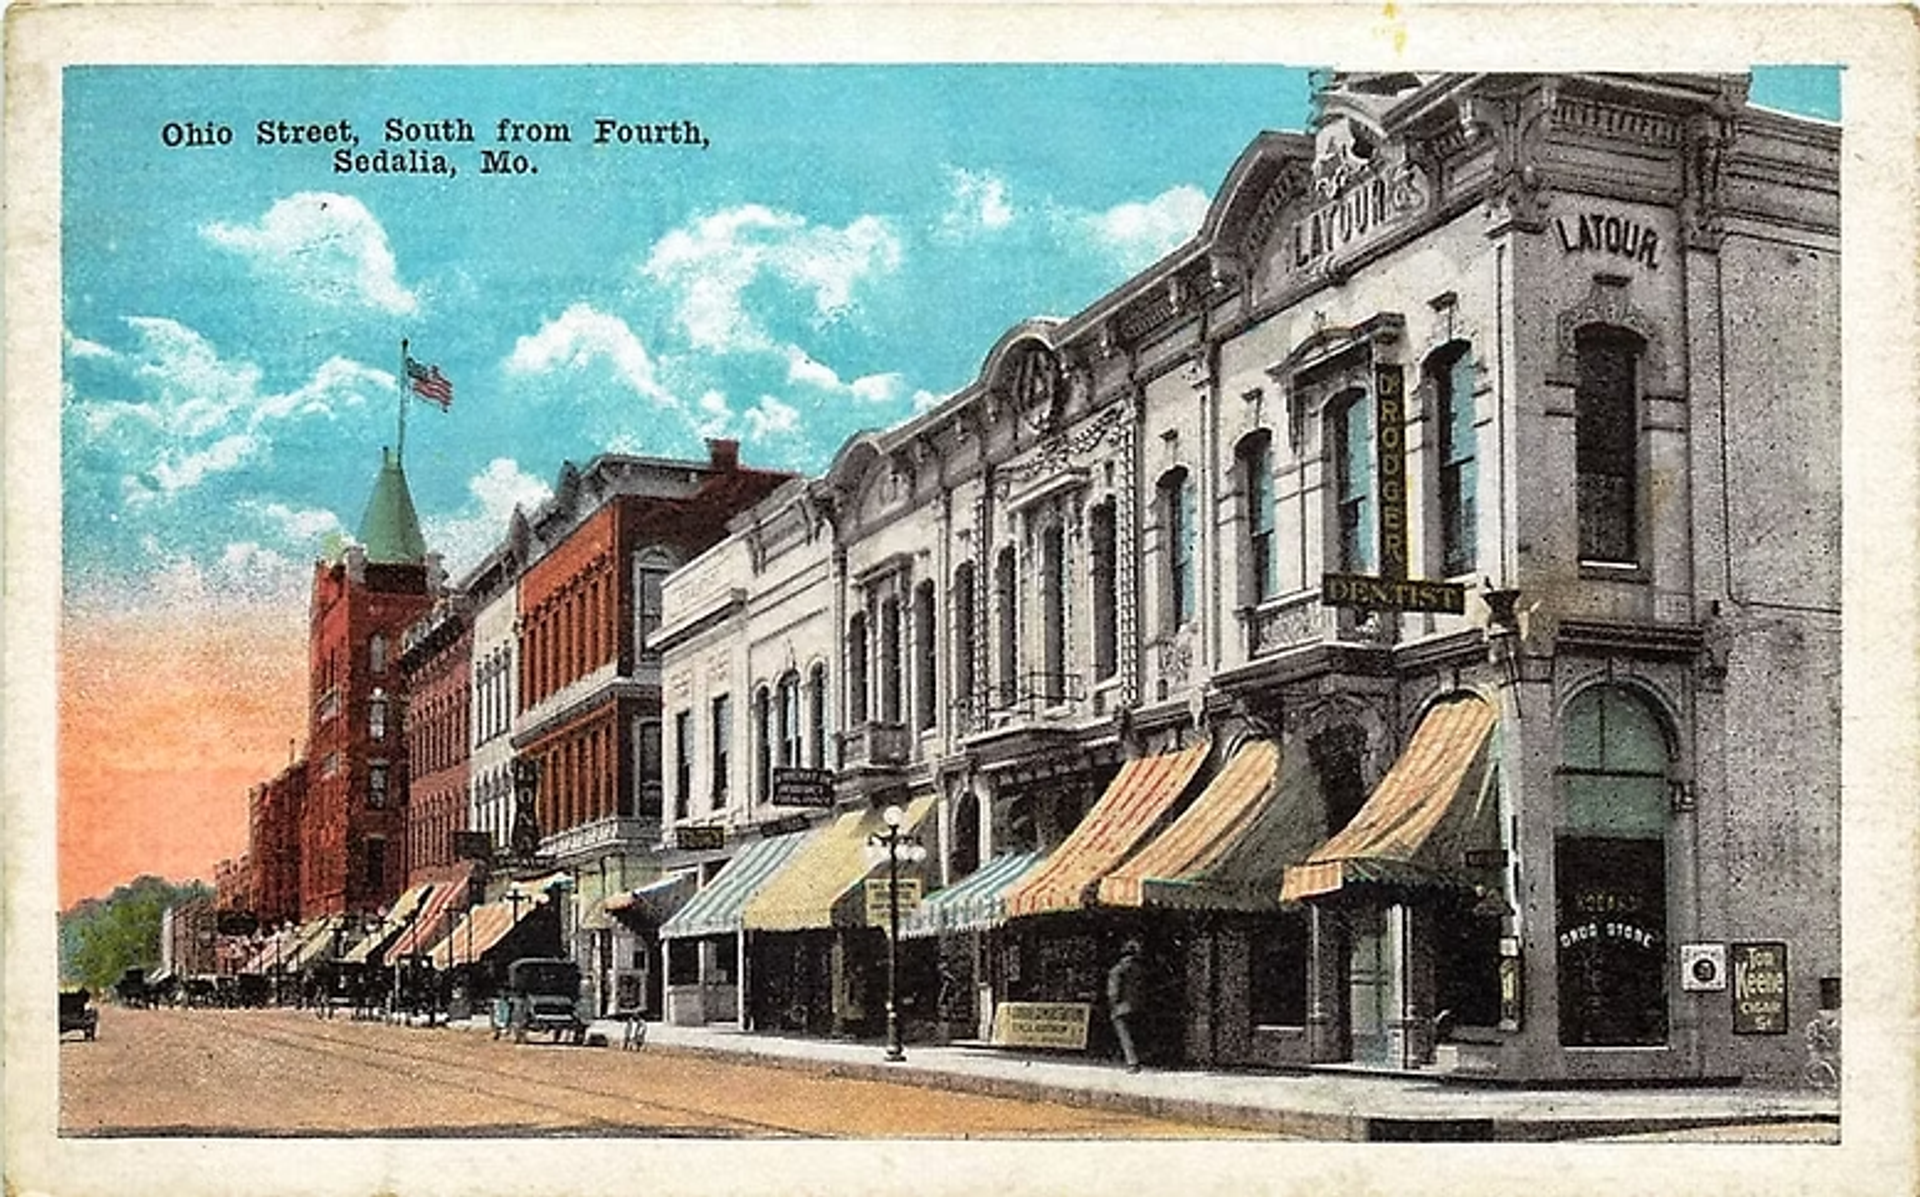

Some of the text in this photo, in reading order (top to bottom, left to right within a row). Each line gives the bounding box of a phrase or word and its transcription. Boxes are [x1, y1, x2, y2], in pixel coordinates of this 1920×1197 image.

[1295, 178, 1386, 268] LATOUR
[1556, 214, 1659, 270] LATOUR
[1328, 578, 1458, 609] DENTIST
[1559, 922, 1655, 949] DRUG STORE
